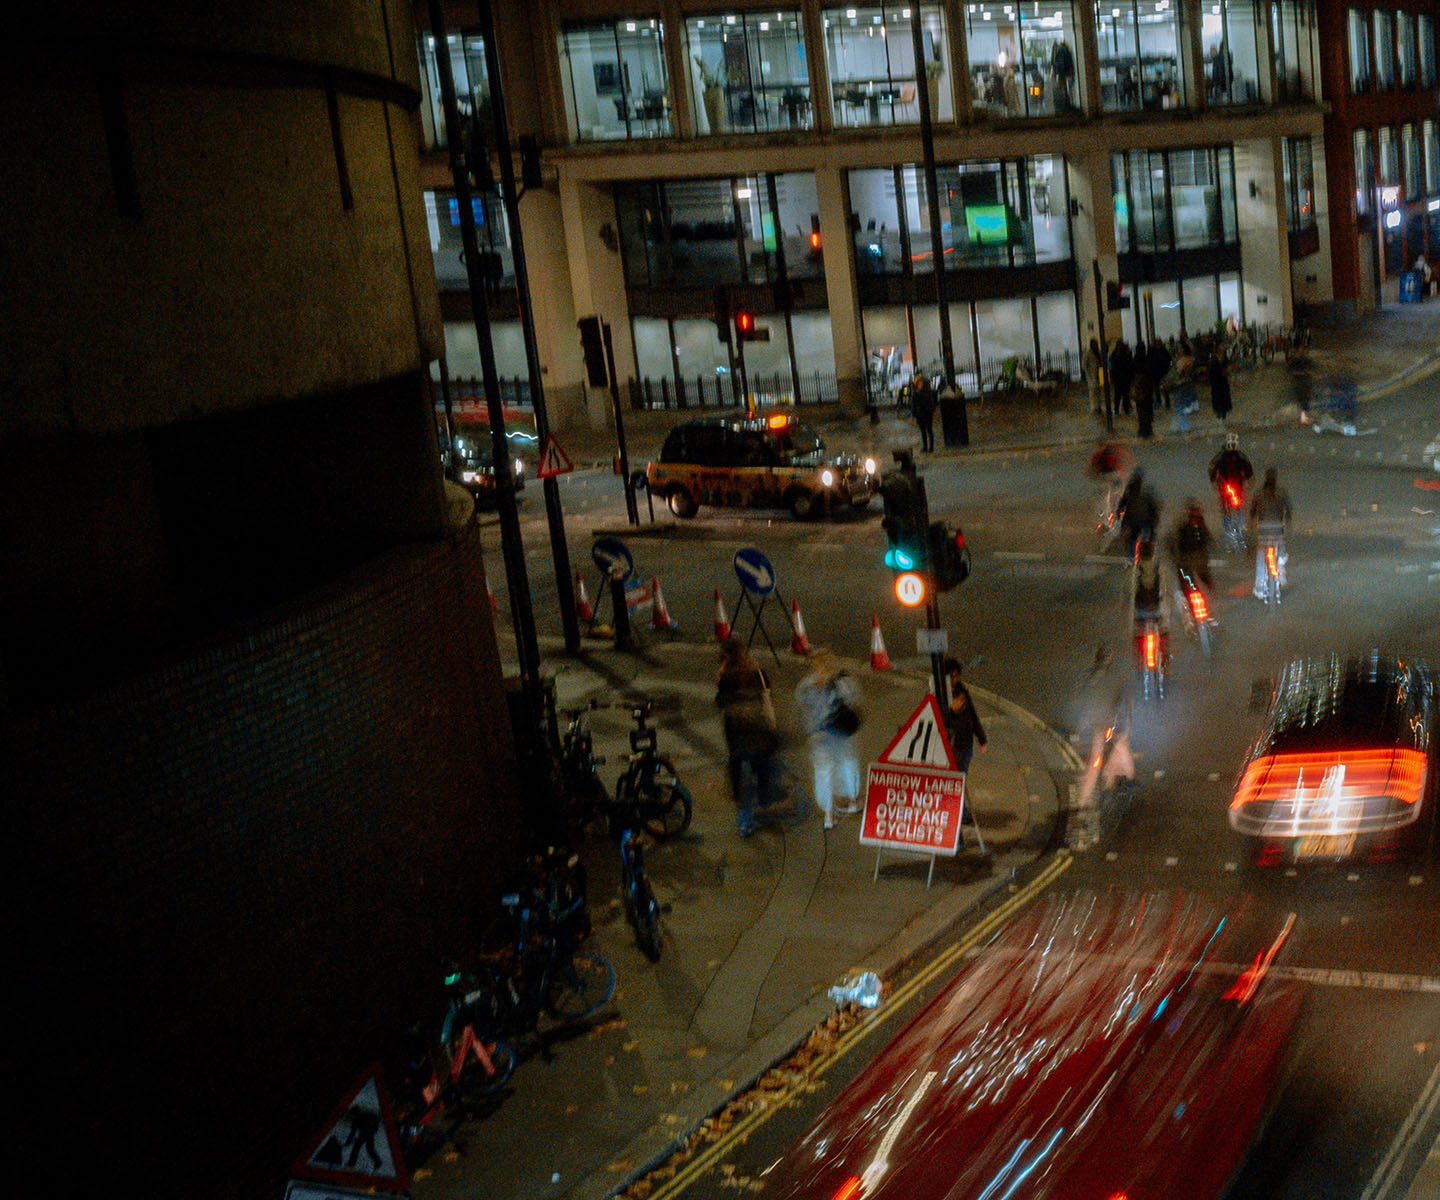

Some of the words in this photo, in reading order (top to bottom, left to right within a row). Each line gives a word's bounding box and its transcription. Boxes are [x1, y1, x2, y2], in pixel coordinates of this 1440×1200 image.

[870, 771, 921, 791] NARROW
[924, 777, 962, 796] LANES
[886, 788, 907, 806] DO
[912, 791, 943, 810] NOT
[876, 803, 949, 829] OVERTAKE
[876, 820, 944, 844] CYCLISTS
